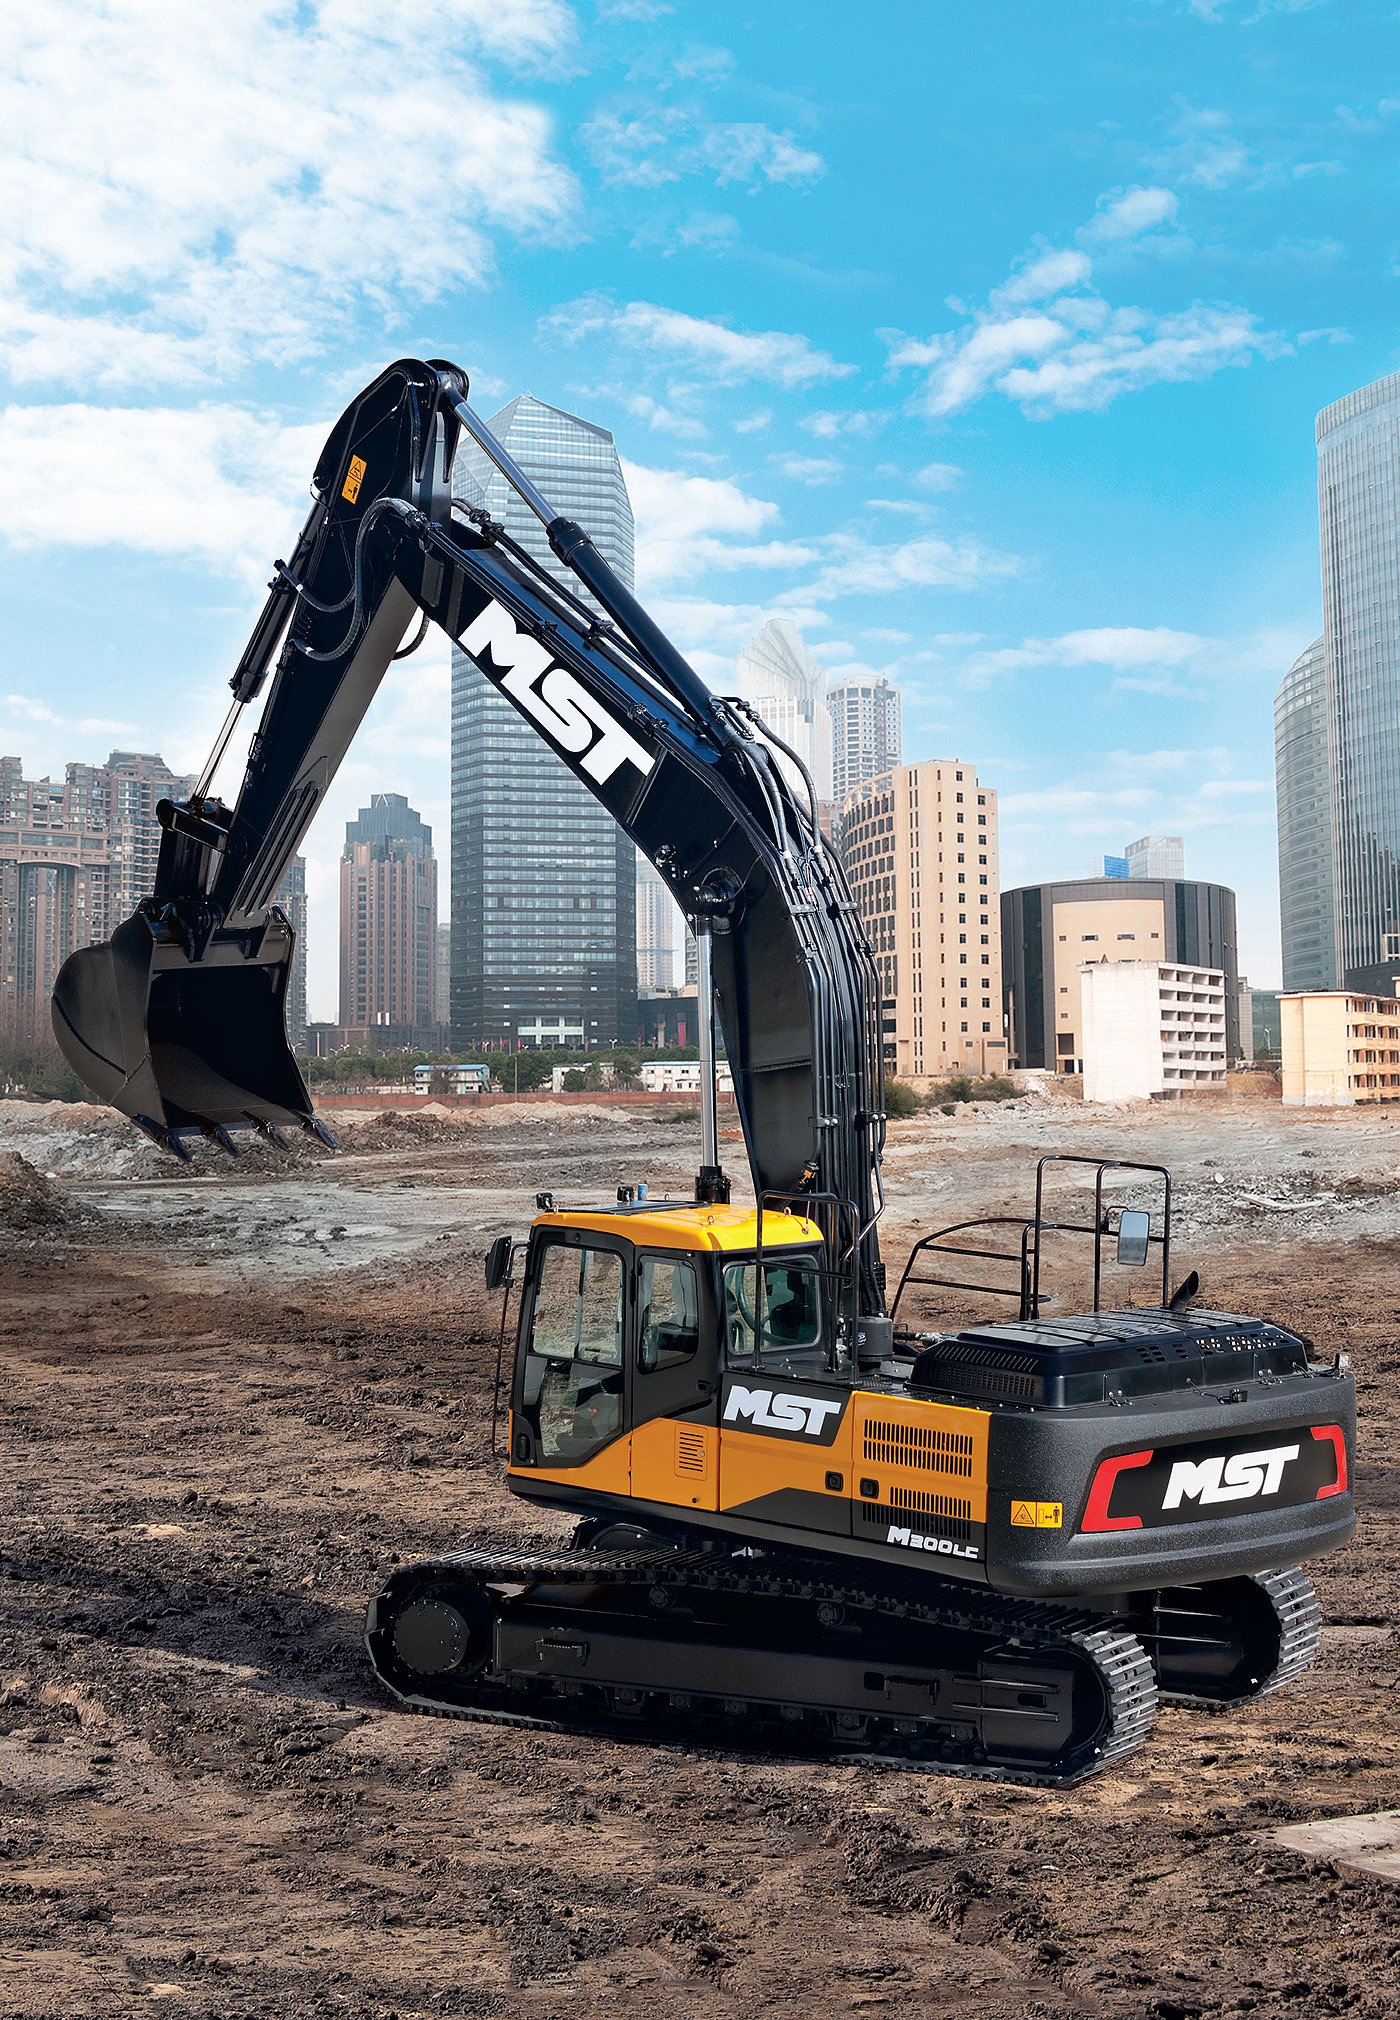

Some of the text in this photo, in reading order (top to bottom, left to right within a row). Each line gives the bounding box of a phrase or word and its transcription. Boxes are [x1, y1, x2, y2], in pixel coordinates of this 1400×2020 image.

[458, 598, 656, 786] MST
[723, 1384, 842, 1436] MST
[1161, 1444, 1300, 1510] MST
[887, 1525, 979, 1559] M300LC
